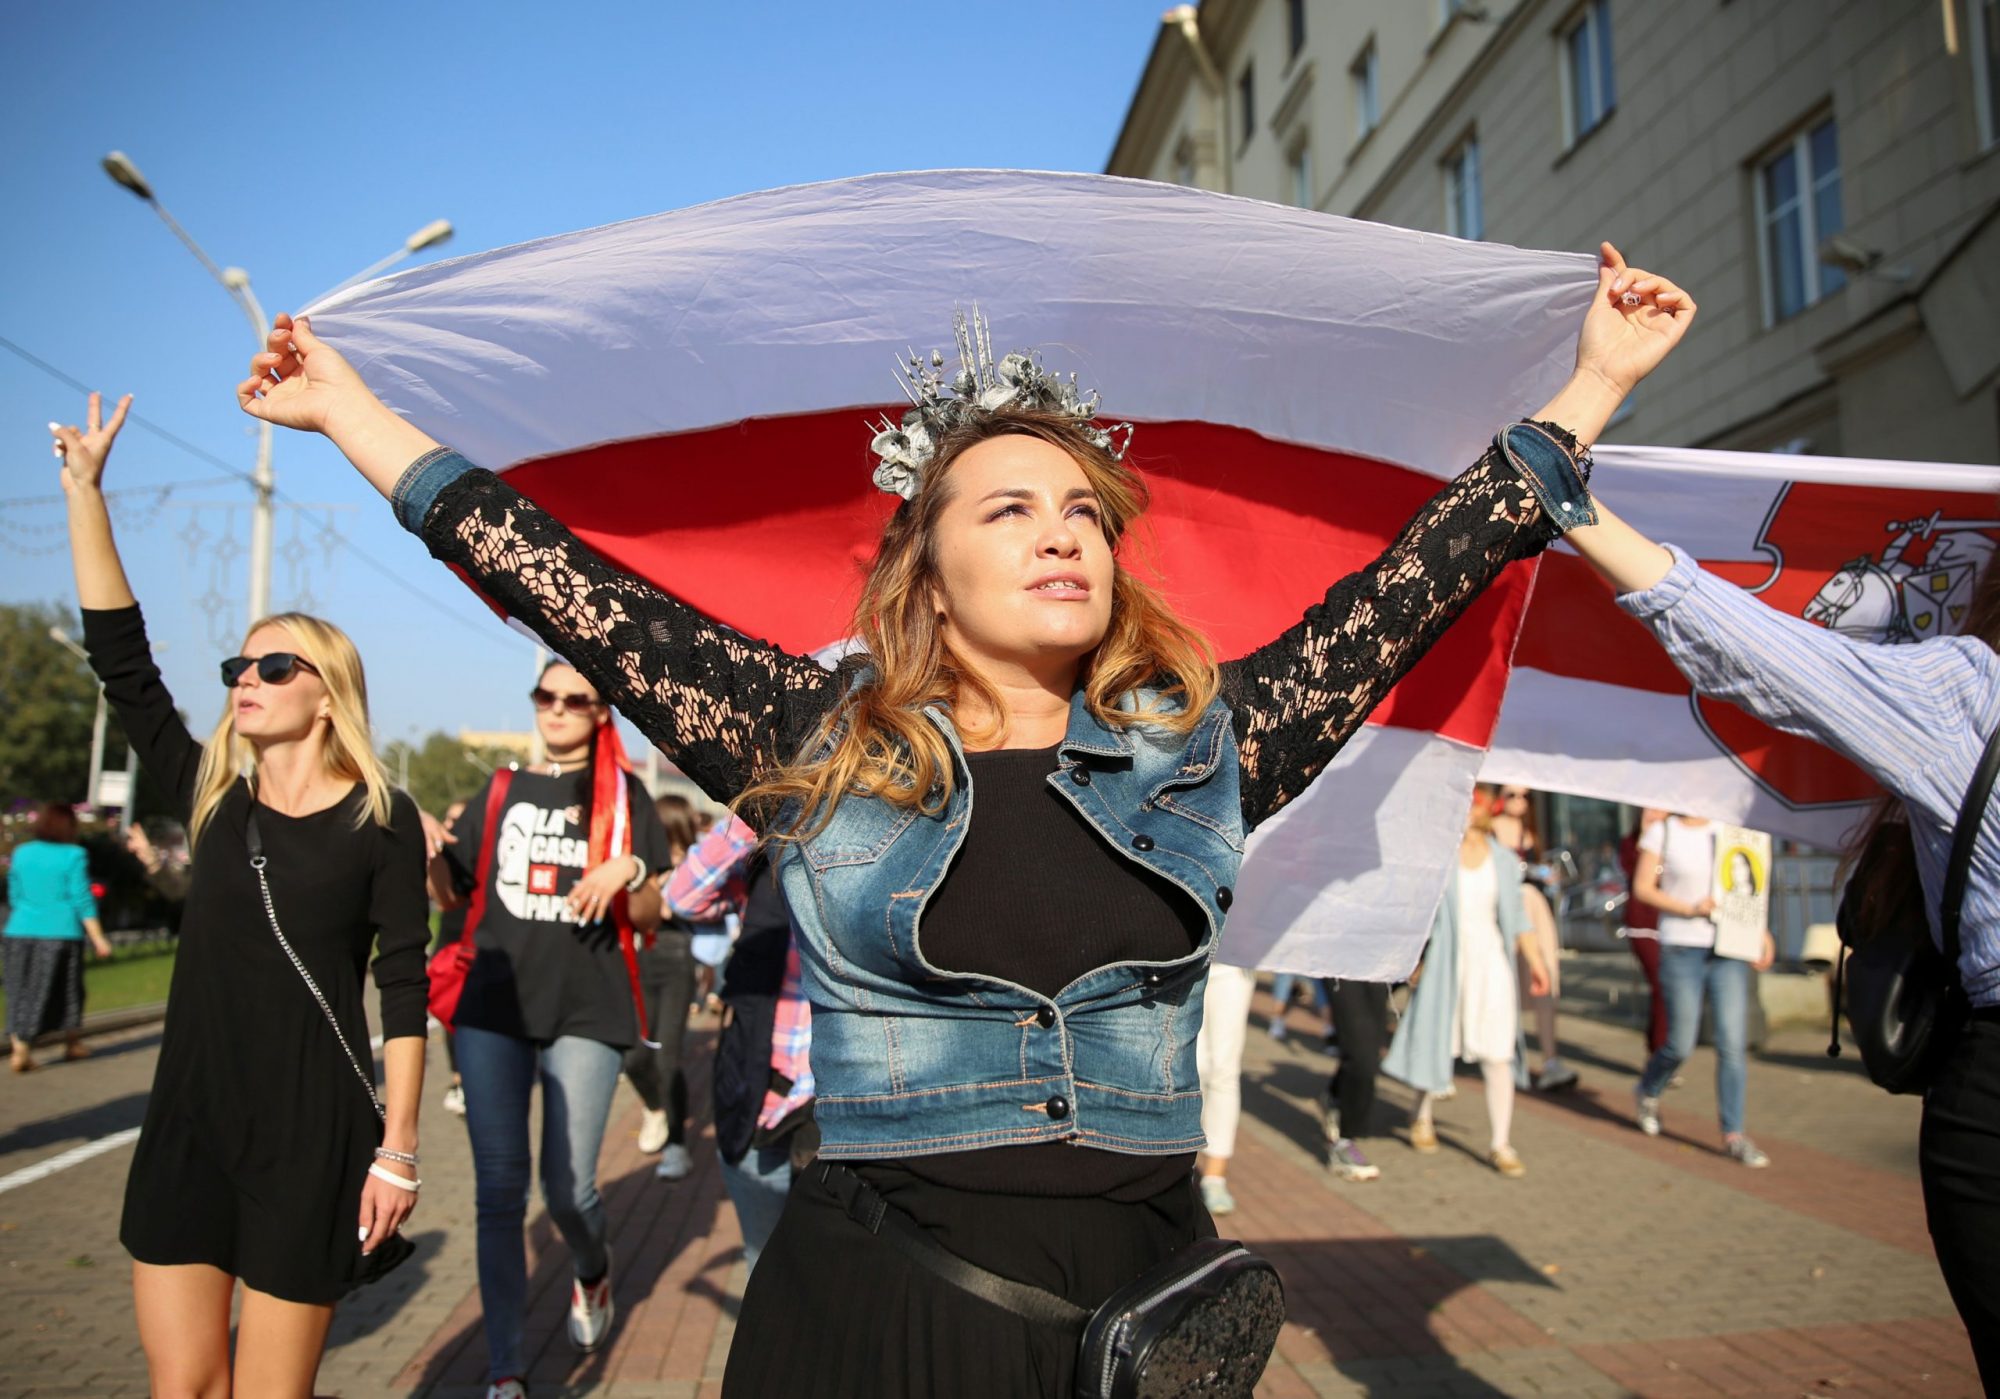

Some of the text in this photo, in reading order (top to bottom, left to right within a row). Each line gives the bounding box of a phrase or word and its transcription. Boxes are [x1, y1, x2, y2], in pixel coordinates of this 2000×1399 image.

[534, 808, 565, 836] LA
[530, 835, 588, 868] CASA
[526, 894, 579, 923] PAPE
